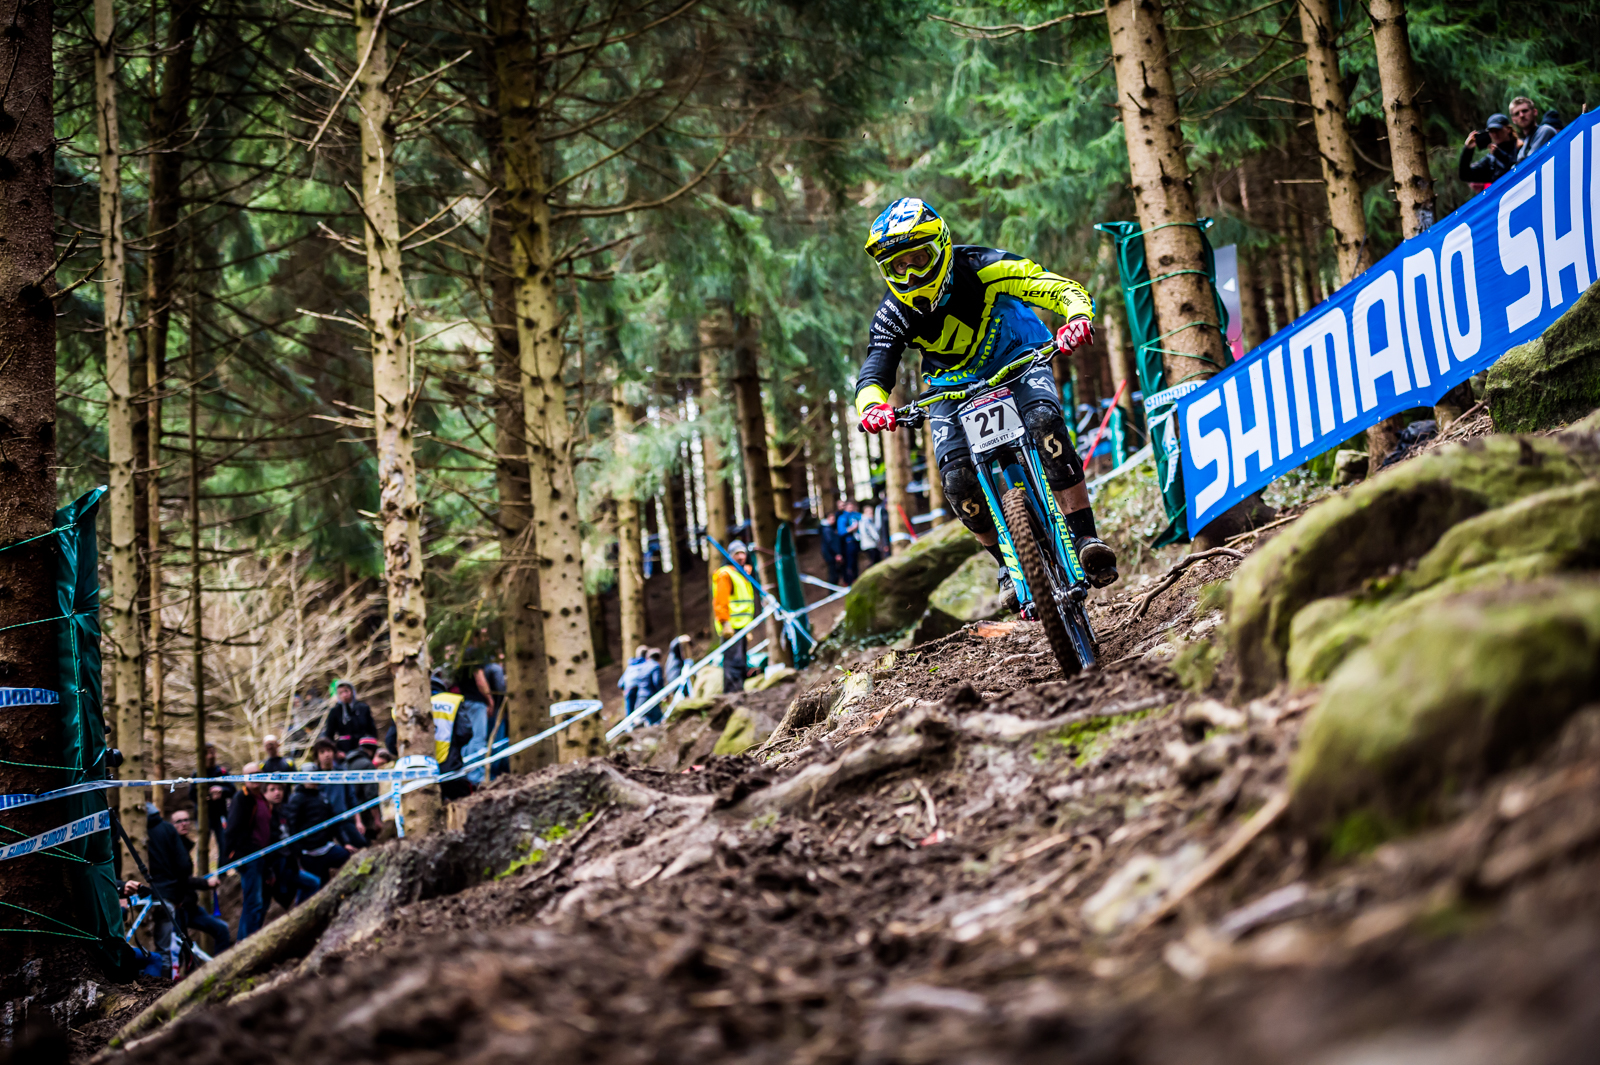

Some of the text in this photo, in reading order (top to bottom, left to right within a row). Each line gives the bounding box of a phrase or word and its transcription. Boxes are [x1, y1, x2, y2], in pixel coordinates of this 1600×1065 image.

[1186, 222, 1482, 519] SHIMANO
[942, 389, 966, 400] 780
[974, 404, 1005, 439] 27
[979, 433, 1010, 450] LOURDES VTT
[1054, 512, 1085, 581] manitou
[434, 703, 452, 712] UCI
